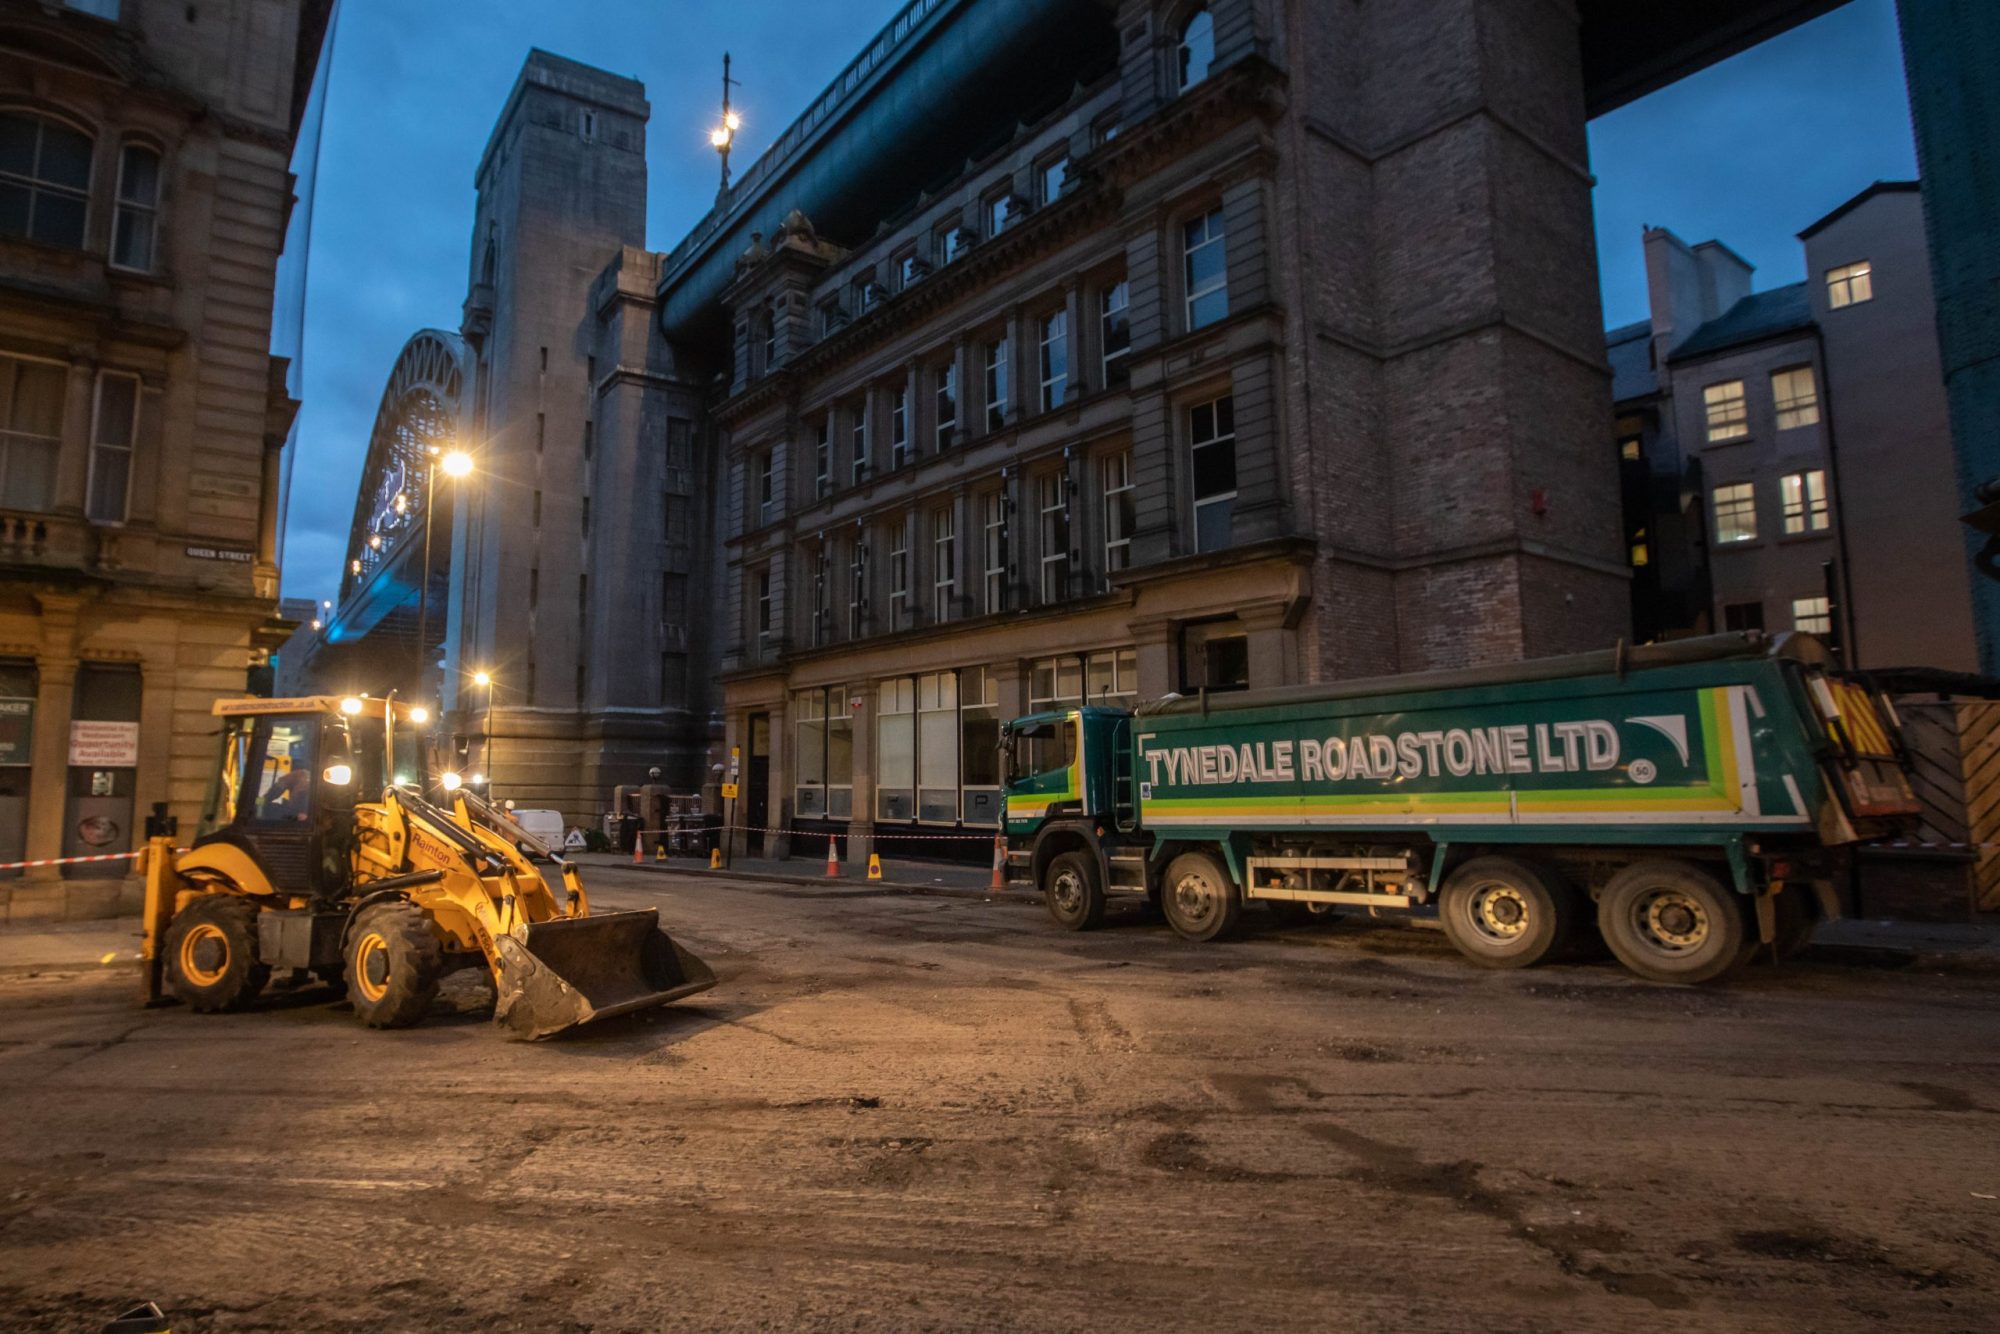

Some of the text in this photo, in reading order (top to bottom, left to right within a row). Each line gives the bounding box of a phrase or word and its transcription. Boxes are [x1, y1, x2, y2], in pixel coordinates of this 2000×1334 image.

[187, 547, 251, 561] QUEEN STREET
[71, 741, 135, 751] Opportunity
[79, 750, 126, 758] Available
[1145, 720, 1620, 786] TYNEDALE ROADSTONE LTD
[1636, 766, 1649, 776] 50
[412, 832, 451, 865] Rainton
